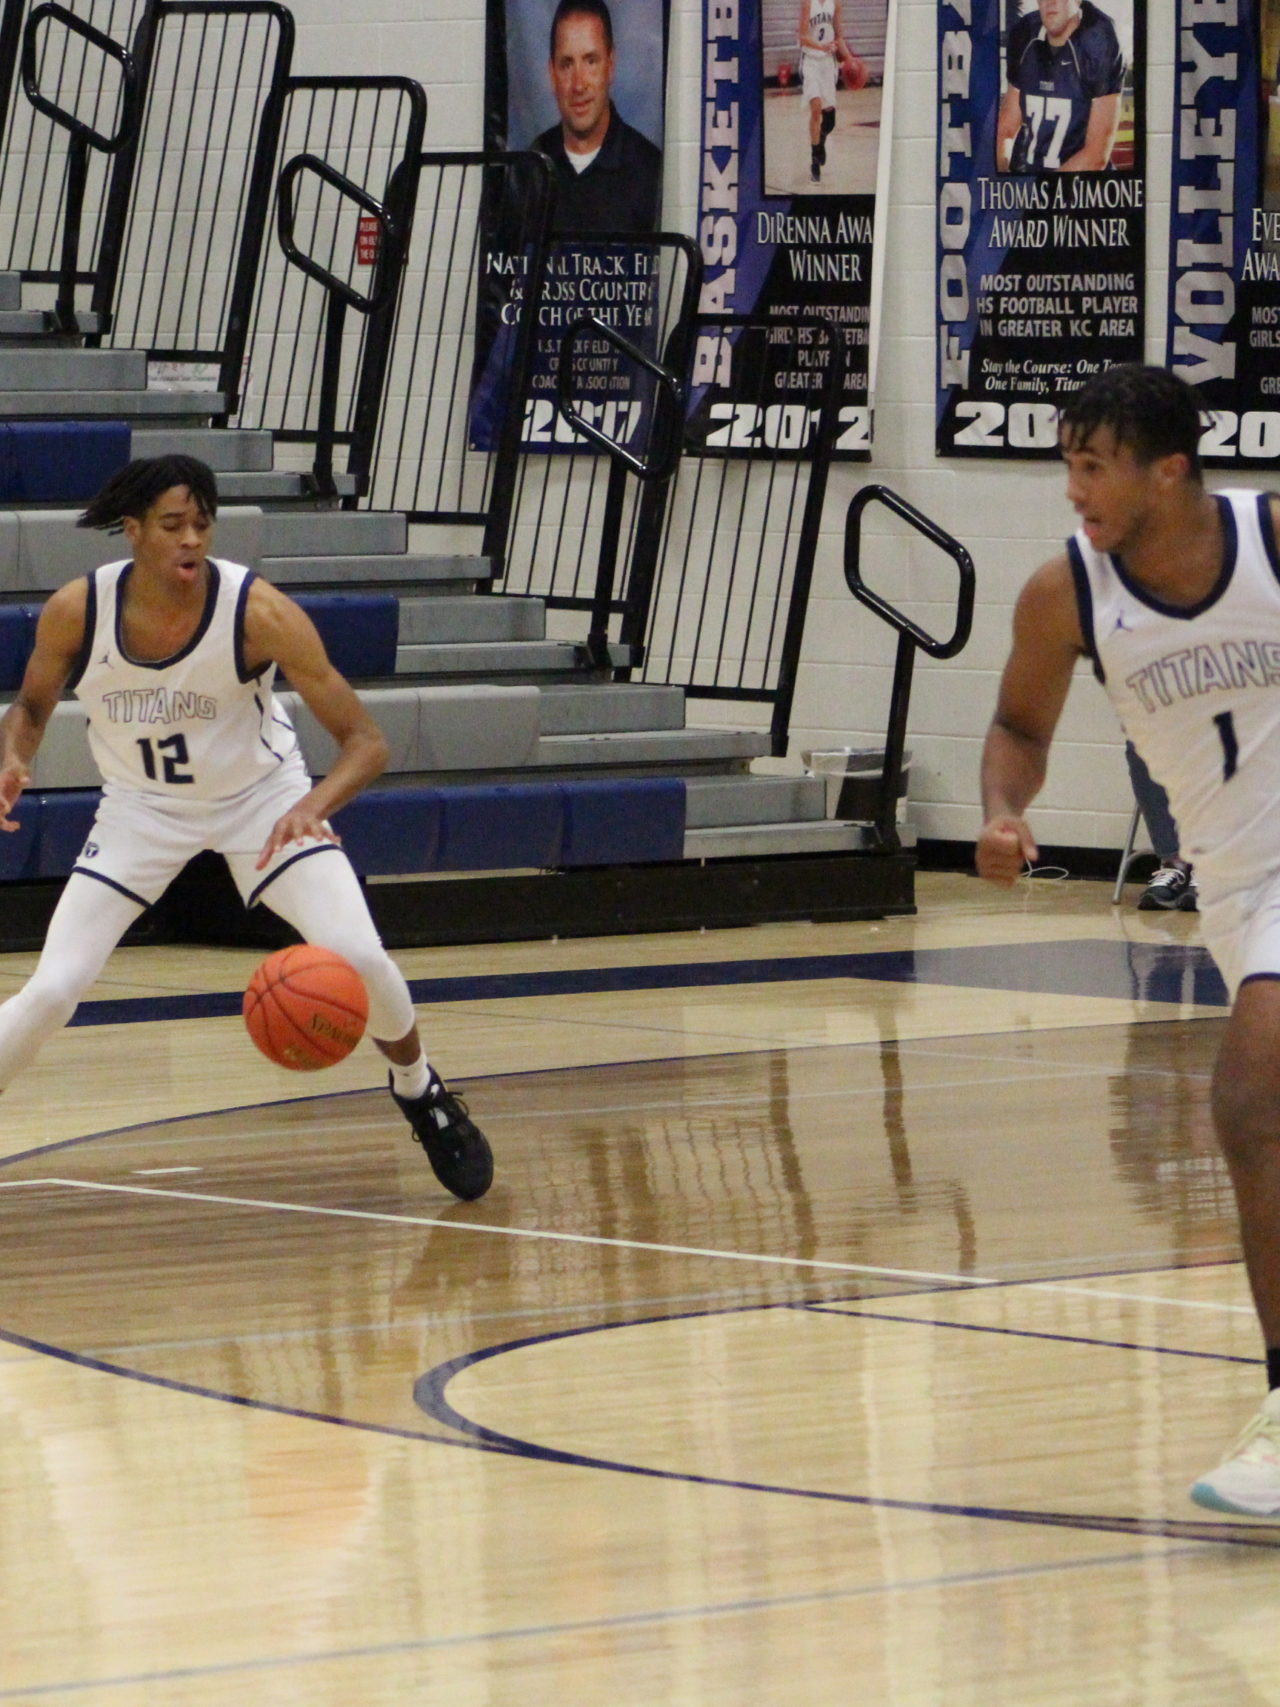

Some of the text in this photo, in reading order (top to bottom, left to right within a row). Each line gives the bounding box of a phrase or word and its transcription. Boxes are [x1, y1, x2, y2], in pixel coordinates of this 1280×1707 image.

[1024, 94, 1072, 169] 77
[977, 177, 1049, 211] THOMAS
[1070, 176, 1144, 208] SIMONE
[988, 215, 1130, 248] AWARD WINNER
[789, 249, 862, 281] WINNER
[980, 273, 1134, 292] MOST OUTSTANDING
[976, 296, 1138, 315] HS FOOTBALL PLAYER
[980, 319, 1135, 338] IN GREATER KC AREA
[981, 358, 1004, 376] Stay
[1005, 359, 1020, 374] the
[1022, 359, 1072, 375] Course:
[1076, 359, 1100, 375] One
[985, 376, 1008, 391] One
[102, 687, 218, 725] TITANS
[136, 733, 196, 785] 12
[1213, 710, 1239, 784] 1
